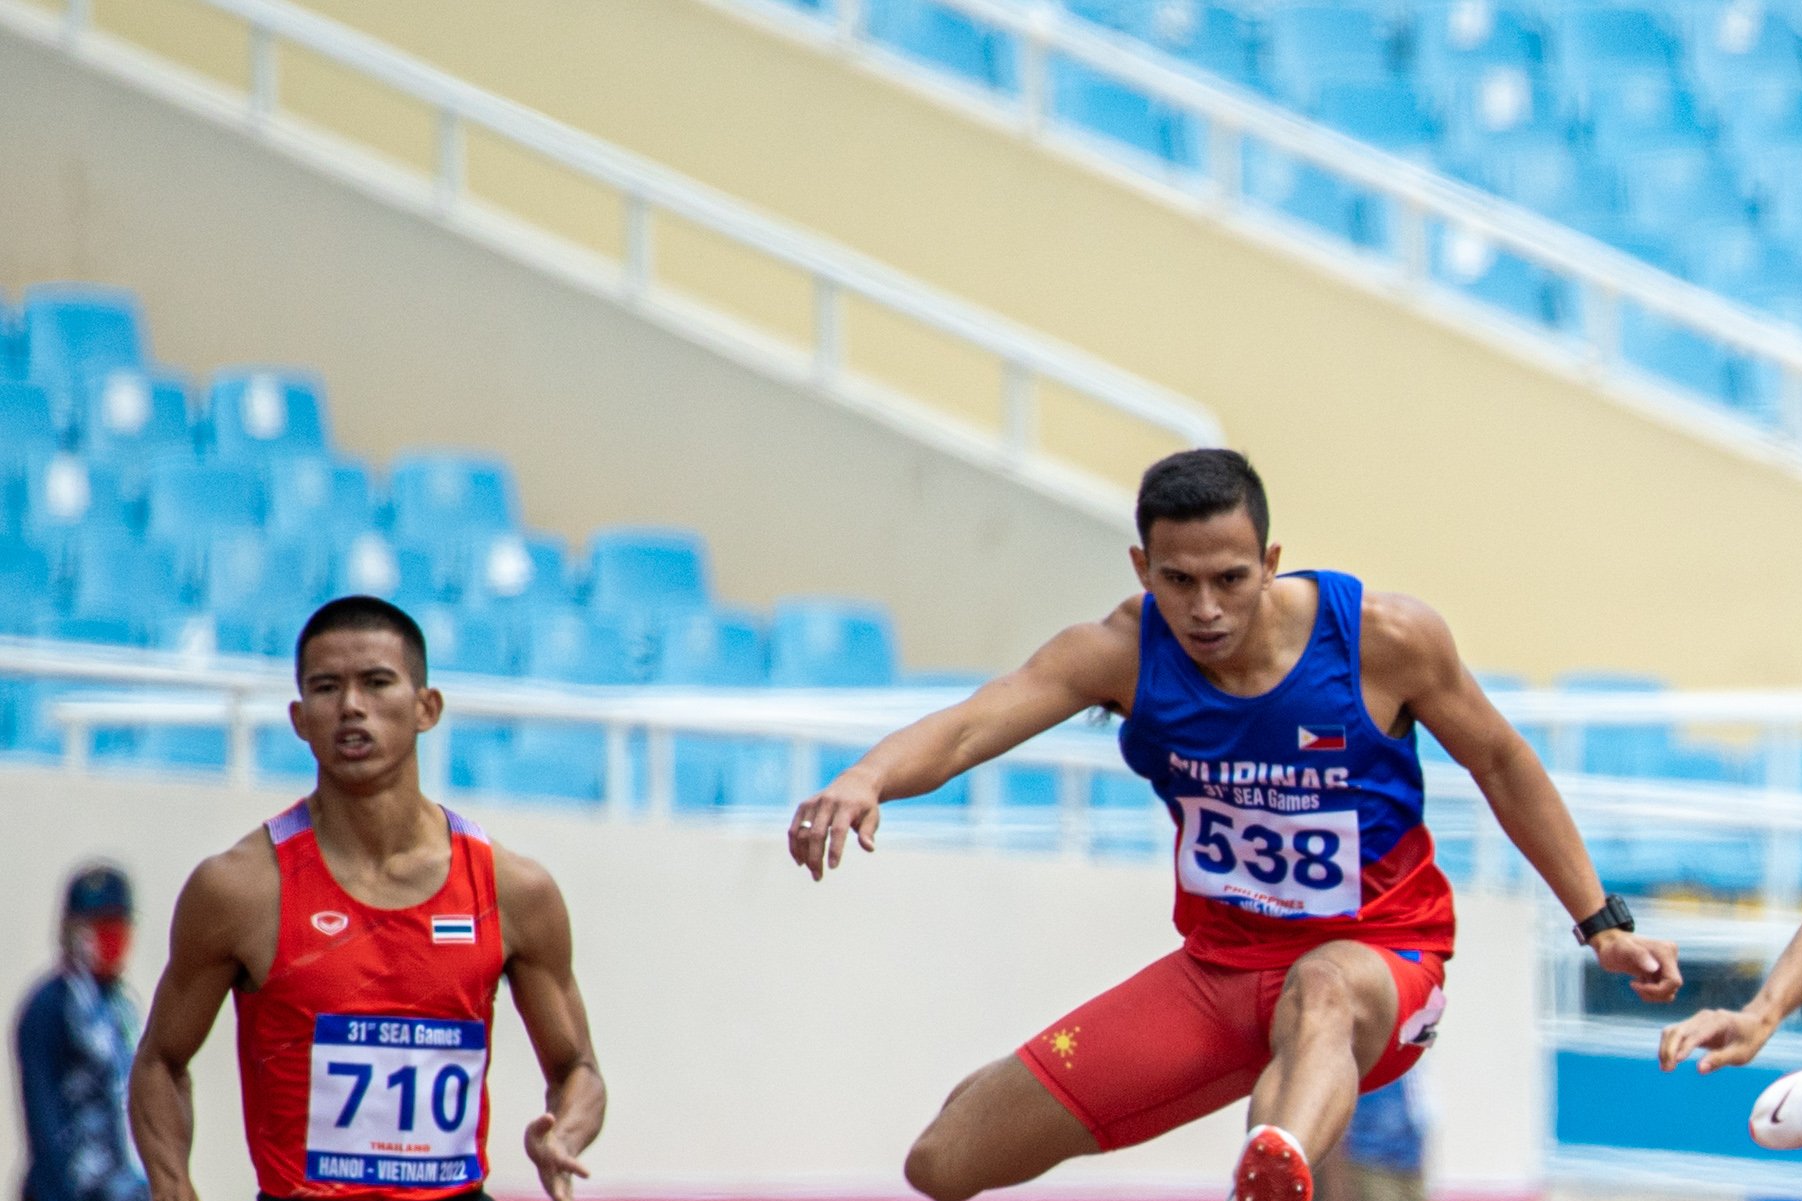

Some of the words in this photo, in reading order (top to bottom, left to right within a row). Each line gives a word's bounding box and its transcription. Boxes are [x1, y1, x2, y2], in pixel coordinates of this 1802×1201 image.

[1233, 786, 1265, 806] SEA
[1267, 788, 1320, 811] Games
[1194, 807, 1344, 890] 538
[379, 1022, 411, 1044] SEA
[414, 1024, 462, 1046] Games
[326, 1061, 470, 1133] 710
[370, 1141, 431, 1152] THAILAND
[318, 1156, 366, 1179] HANOI
[377, 1159, 438, 1183] VIETNAM
[439, 1160, 469, 1182] 2022
